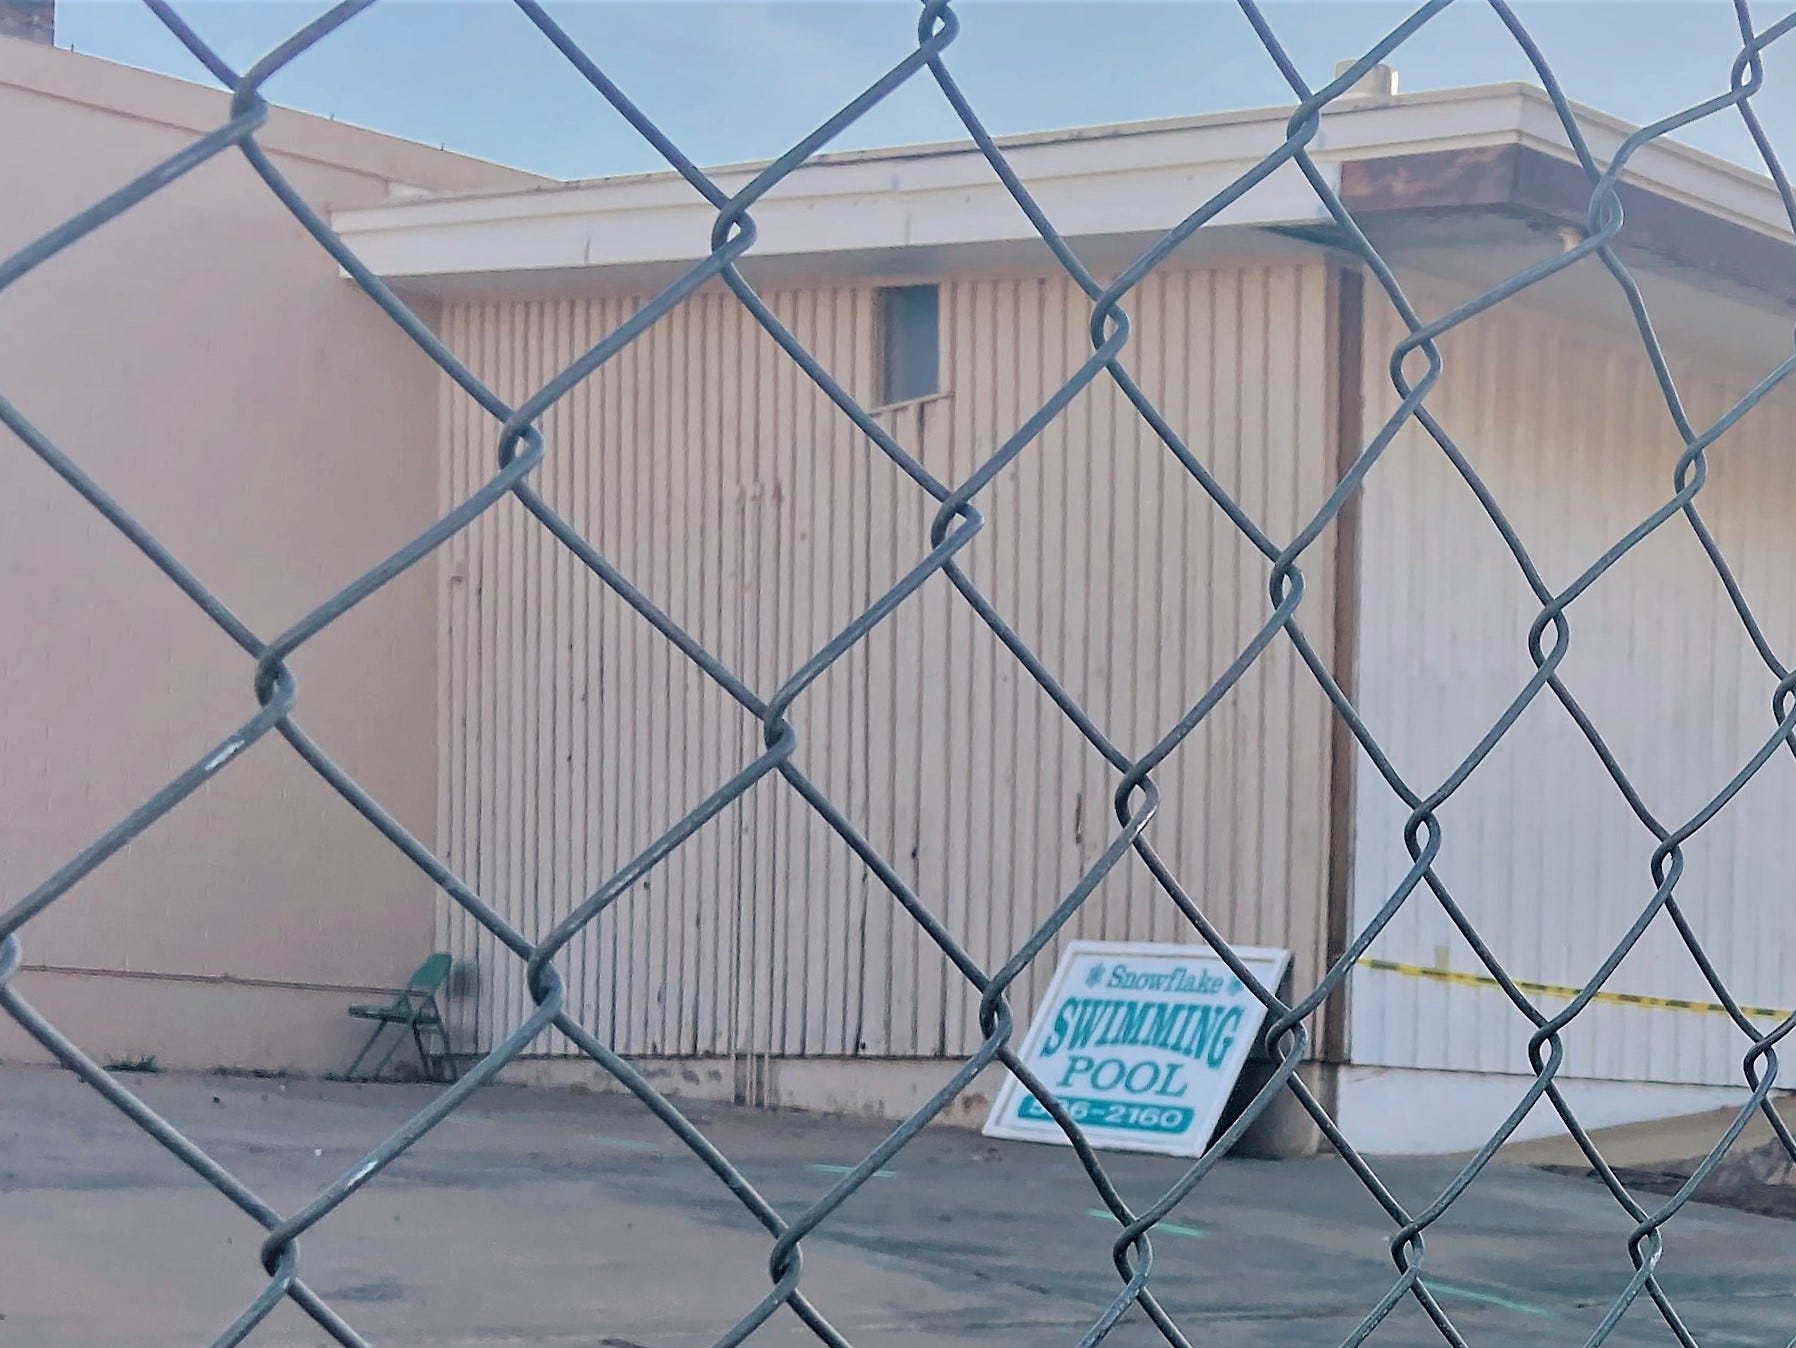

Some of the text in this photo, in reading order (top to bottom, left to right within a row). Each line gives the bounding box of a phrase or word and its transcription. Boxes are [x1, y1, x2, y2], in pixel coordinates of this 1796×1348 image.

[1106, 964, 1223, 993] Snowflake
[1040, 997, 1246, 1069] SWIMMING
[1057, 1056, 1188, 1097] POOL
